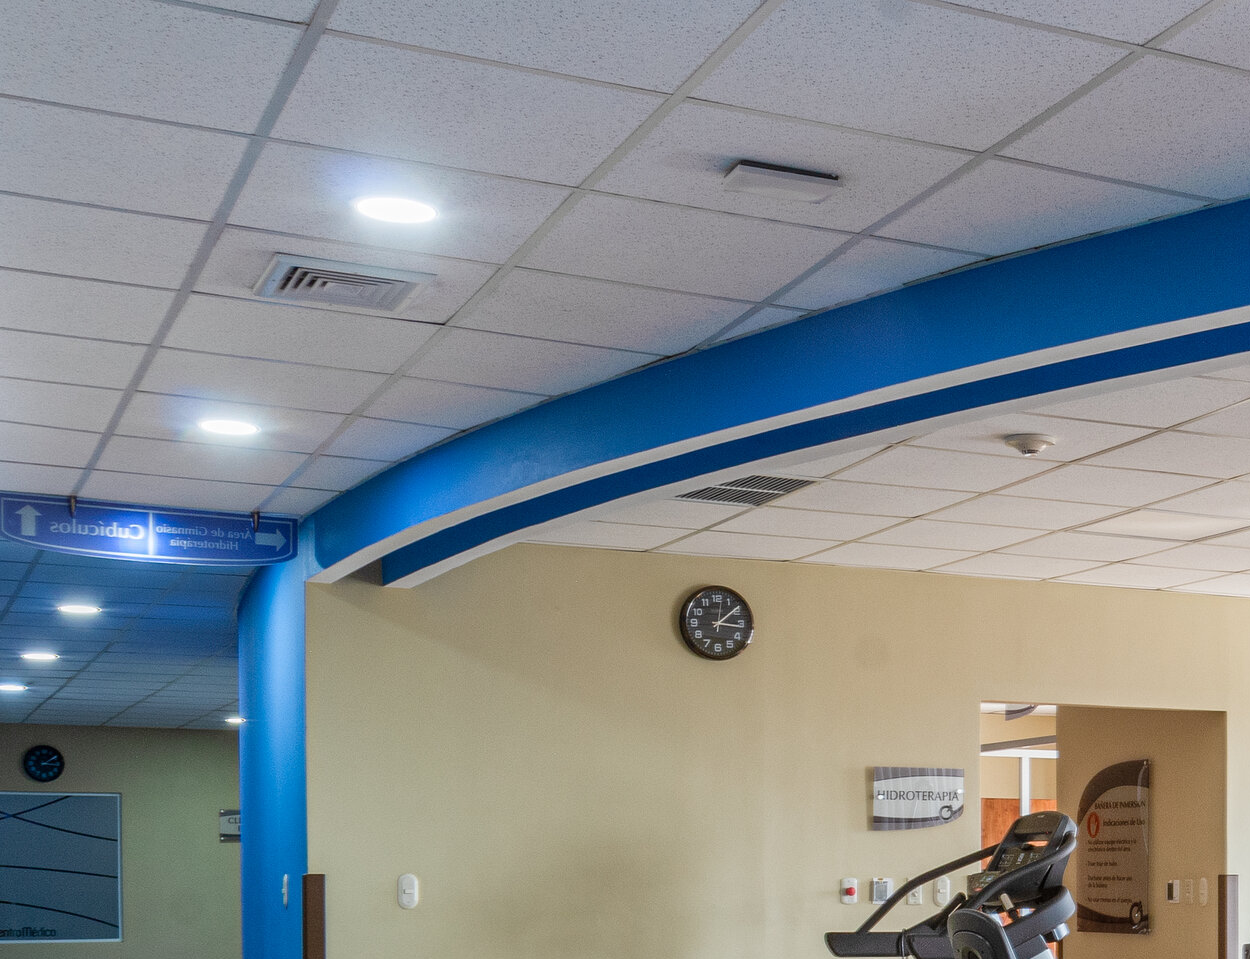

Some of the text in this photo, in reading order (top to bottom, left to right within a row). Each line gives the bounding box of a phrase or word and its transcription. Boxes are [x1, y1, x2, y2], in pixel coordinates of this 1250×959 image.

[701, 598, 709, 607] 11
[711, 594, 723, 603] 12
[693, 608, 703, 616] 10
[690, 618, 698, 627] 9
[737, 619, 745, 628] 3
[694, 630, 702, 639] 8
[733, 632, 741, 640] 4
[703, 639, 711, 648] 7
[714, 643, 722, 652] 6
[726, 640, 734, 648] 5
[877, 789, 960, 802] HIDROTERAPIA
